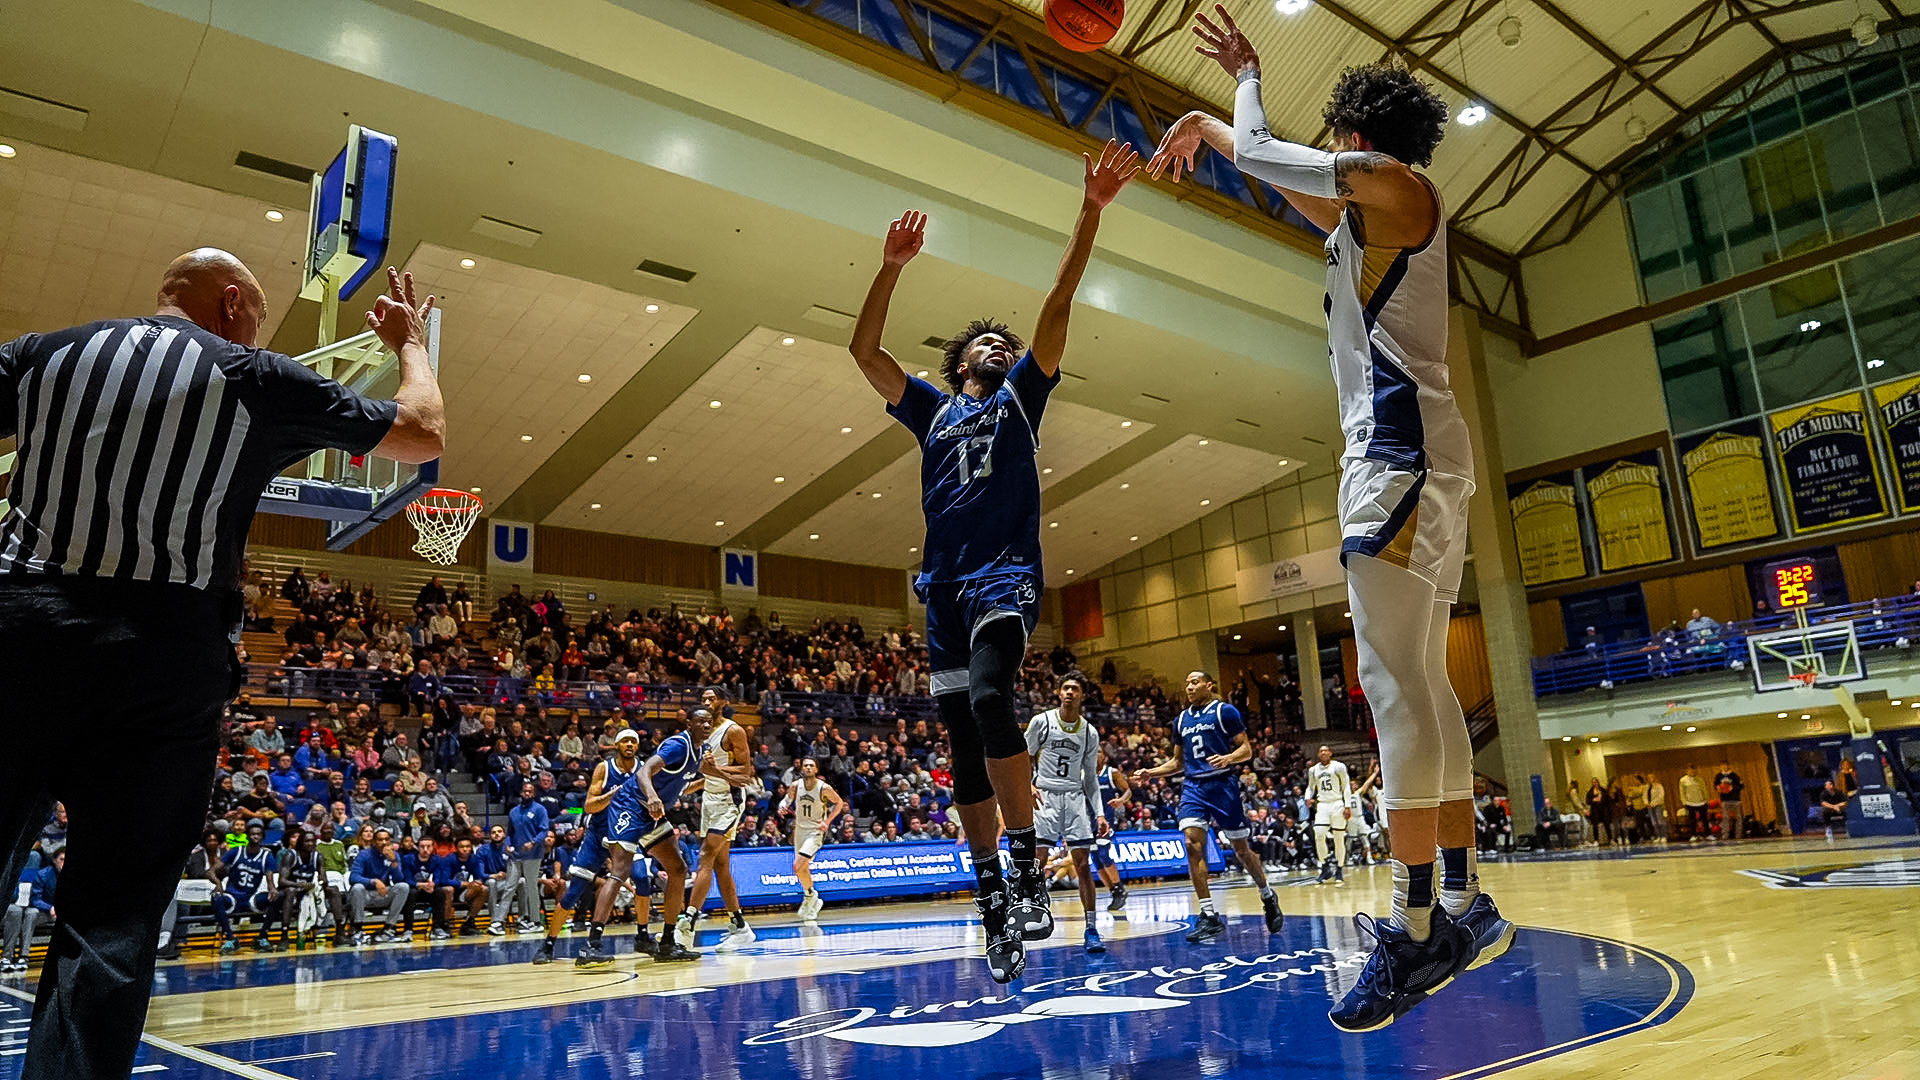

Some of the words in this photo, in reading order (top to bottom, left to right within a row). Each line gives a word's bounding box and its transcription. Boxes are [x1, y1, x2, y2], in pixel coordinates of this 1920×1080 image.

[1883, 396, 1915, 425] THE
[1778, 422, 1808, 449] THE
[1809, 412, 1863, 434] MOUNT
[1809, 444, 1840, 462] NCAA
[1797, 460, 1829, 479] FINAL
[1830, 454, 1859, 472] FOUR
[494, 524, 529, 563] U
[725, 552, 755, 587] N
[1776, 564, 1814, 585] 3:22
[1779, 582, 1808, 607] 25
[1191, 735, 1206, 759] 2
[1056, 755, 1070, 778] 5
[1320, 779, 1333, 791] 45
[802, 804, 812, 818] 11
[849, 856, 893, 868] Certificate
[892, 855, 909, 866] and
[909, 852, 955, 864] Accelerated
[828, 870, 871, 882] Programs
[870, 868, 898, 878] Online
[913, 865, 951, 875] Frederick
[742, 994, 1017, 1045] Jim
